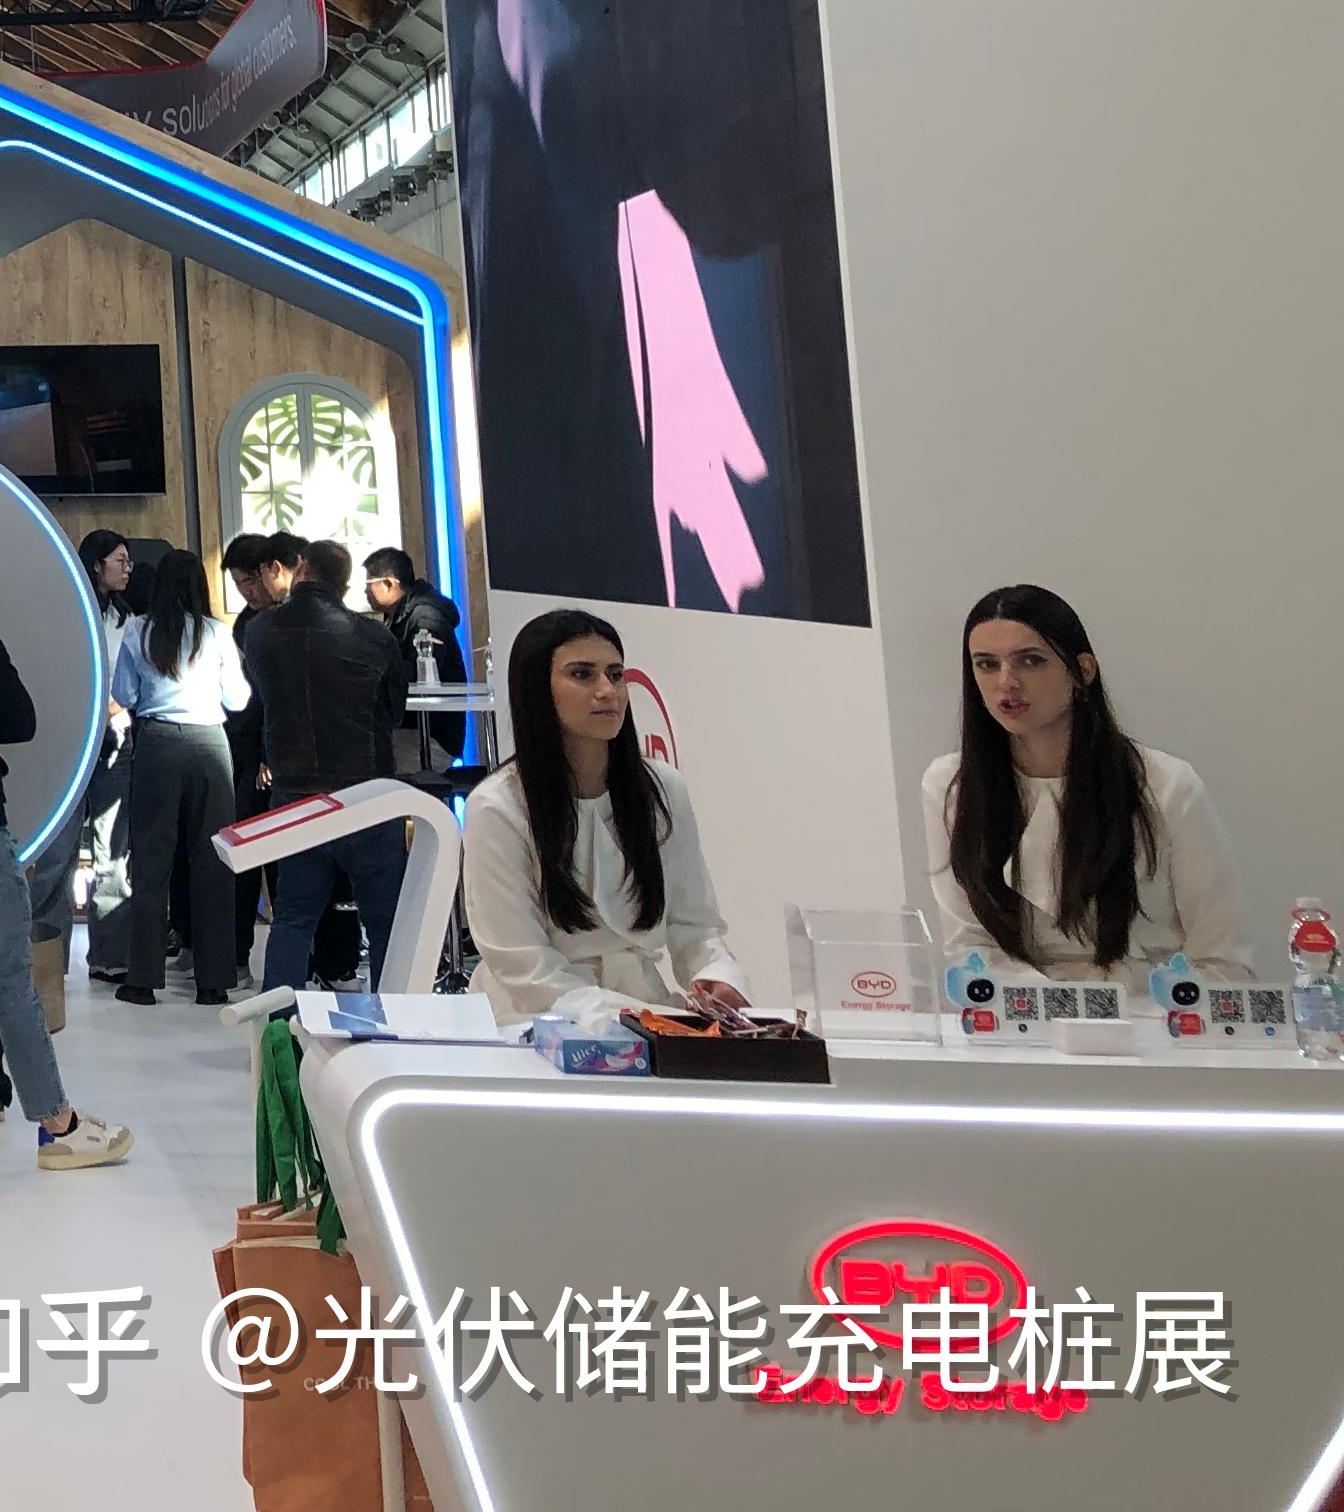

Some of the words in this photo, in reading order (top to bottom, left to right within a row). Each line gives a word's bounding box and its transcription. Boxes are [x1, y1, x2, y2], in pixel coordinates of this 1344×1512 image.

[856, 979, 892, 989] BYD
[841, 1000, 873, 1011] Energy
[876, 1001, 912, 1011] Storage
[840, 1259, 1005, 1309] BYD
